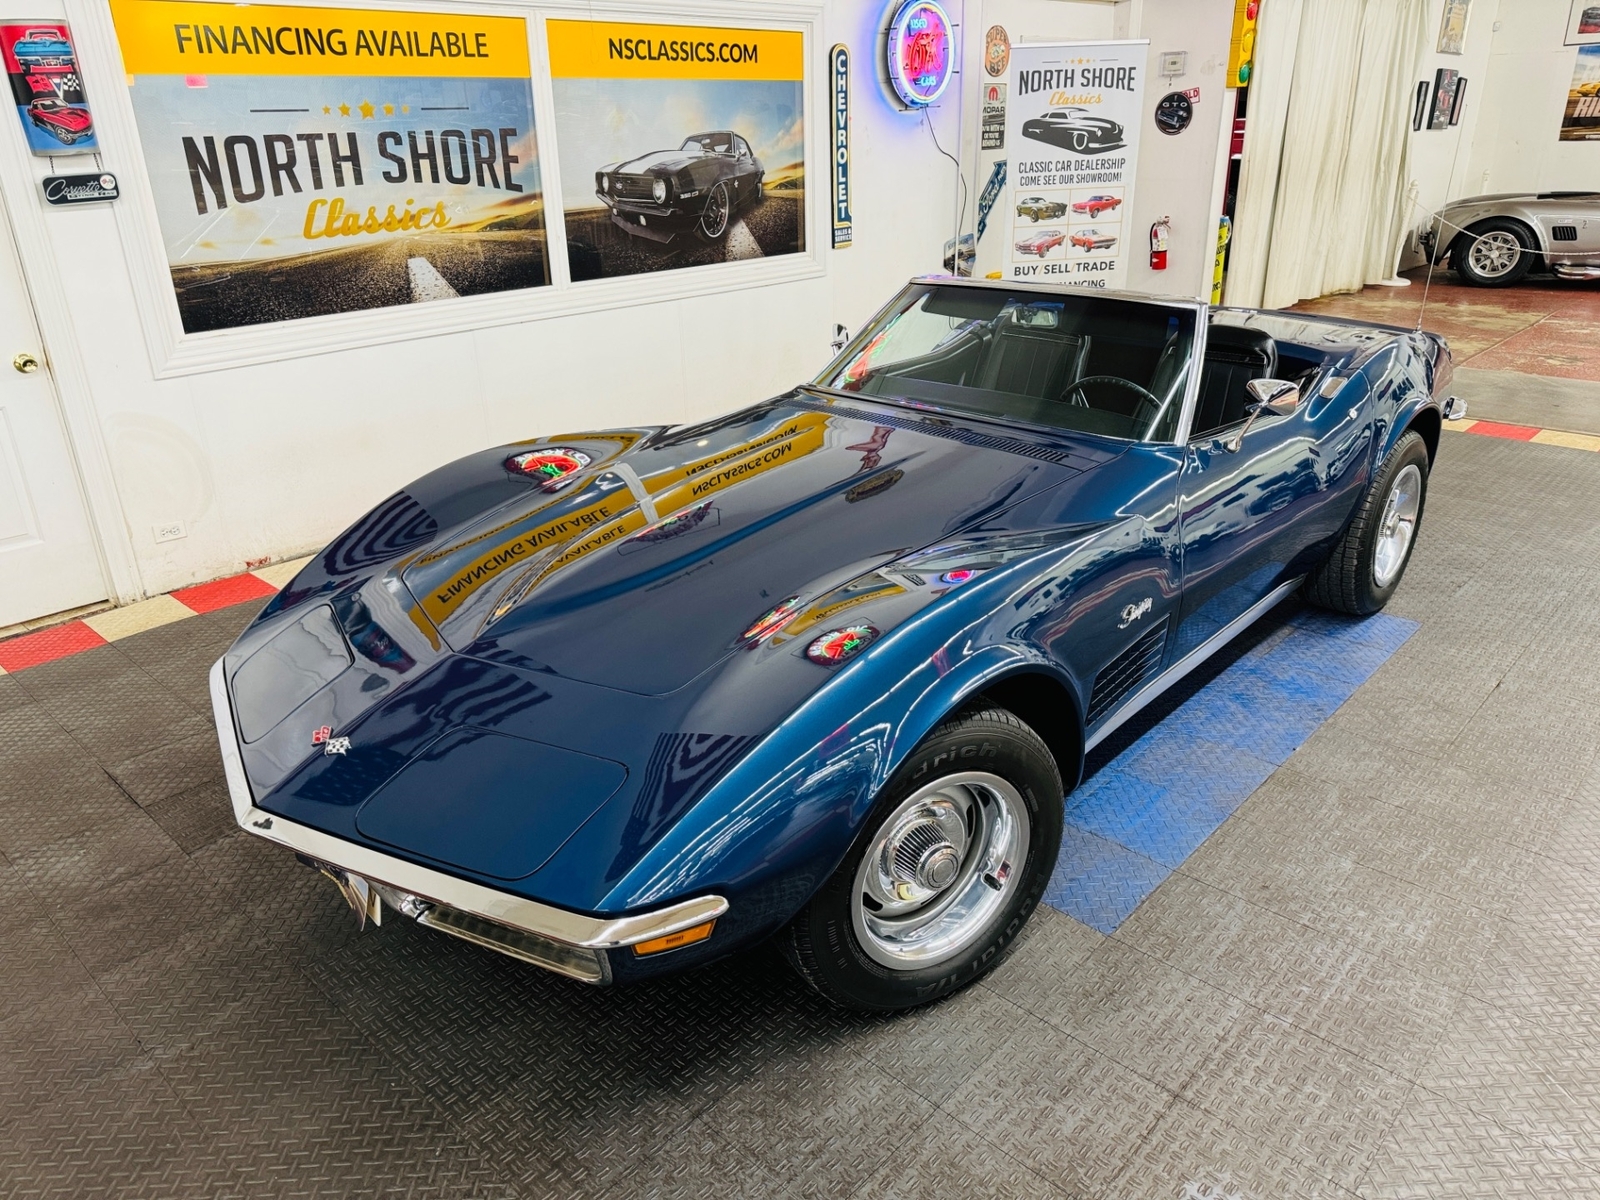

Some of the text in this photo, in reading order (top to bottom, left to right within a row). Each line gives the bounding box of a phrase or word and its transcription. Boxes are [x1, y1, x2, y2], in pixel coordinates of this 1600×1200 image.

[174, 24, 489, 58] FINANCING AVAILABLE
[608, 38, 758, 63] NSCLASSICS.COM
[1018, 67, 1136, 96] NORTH SHORE
[1049, 91, 1103, 105] Classics
[836, 55, 848, 219] CHEVROLET
[181, 127, 524, 215] NORTH SHORE
[1018, 158, 1126, 174] CLASSIC CAR DEALERSHIP
[1020, 172, 1122, 186] COME SEE OUR SHOWROOM!
[303, 197, 452, 240] Classics
